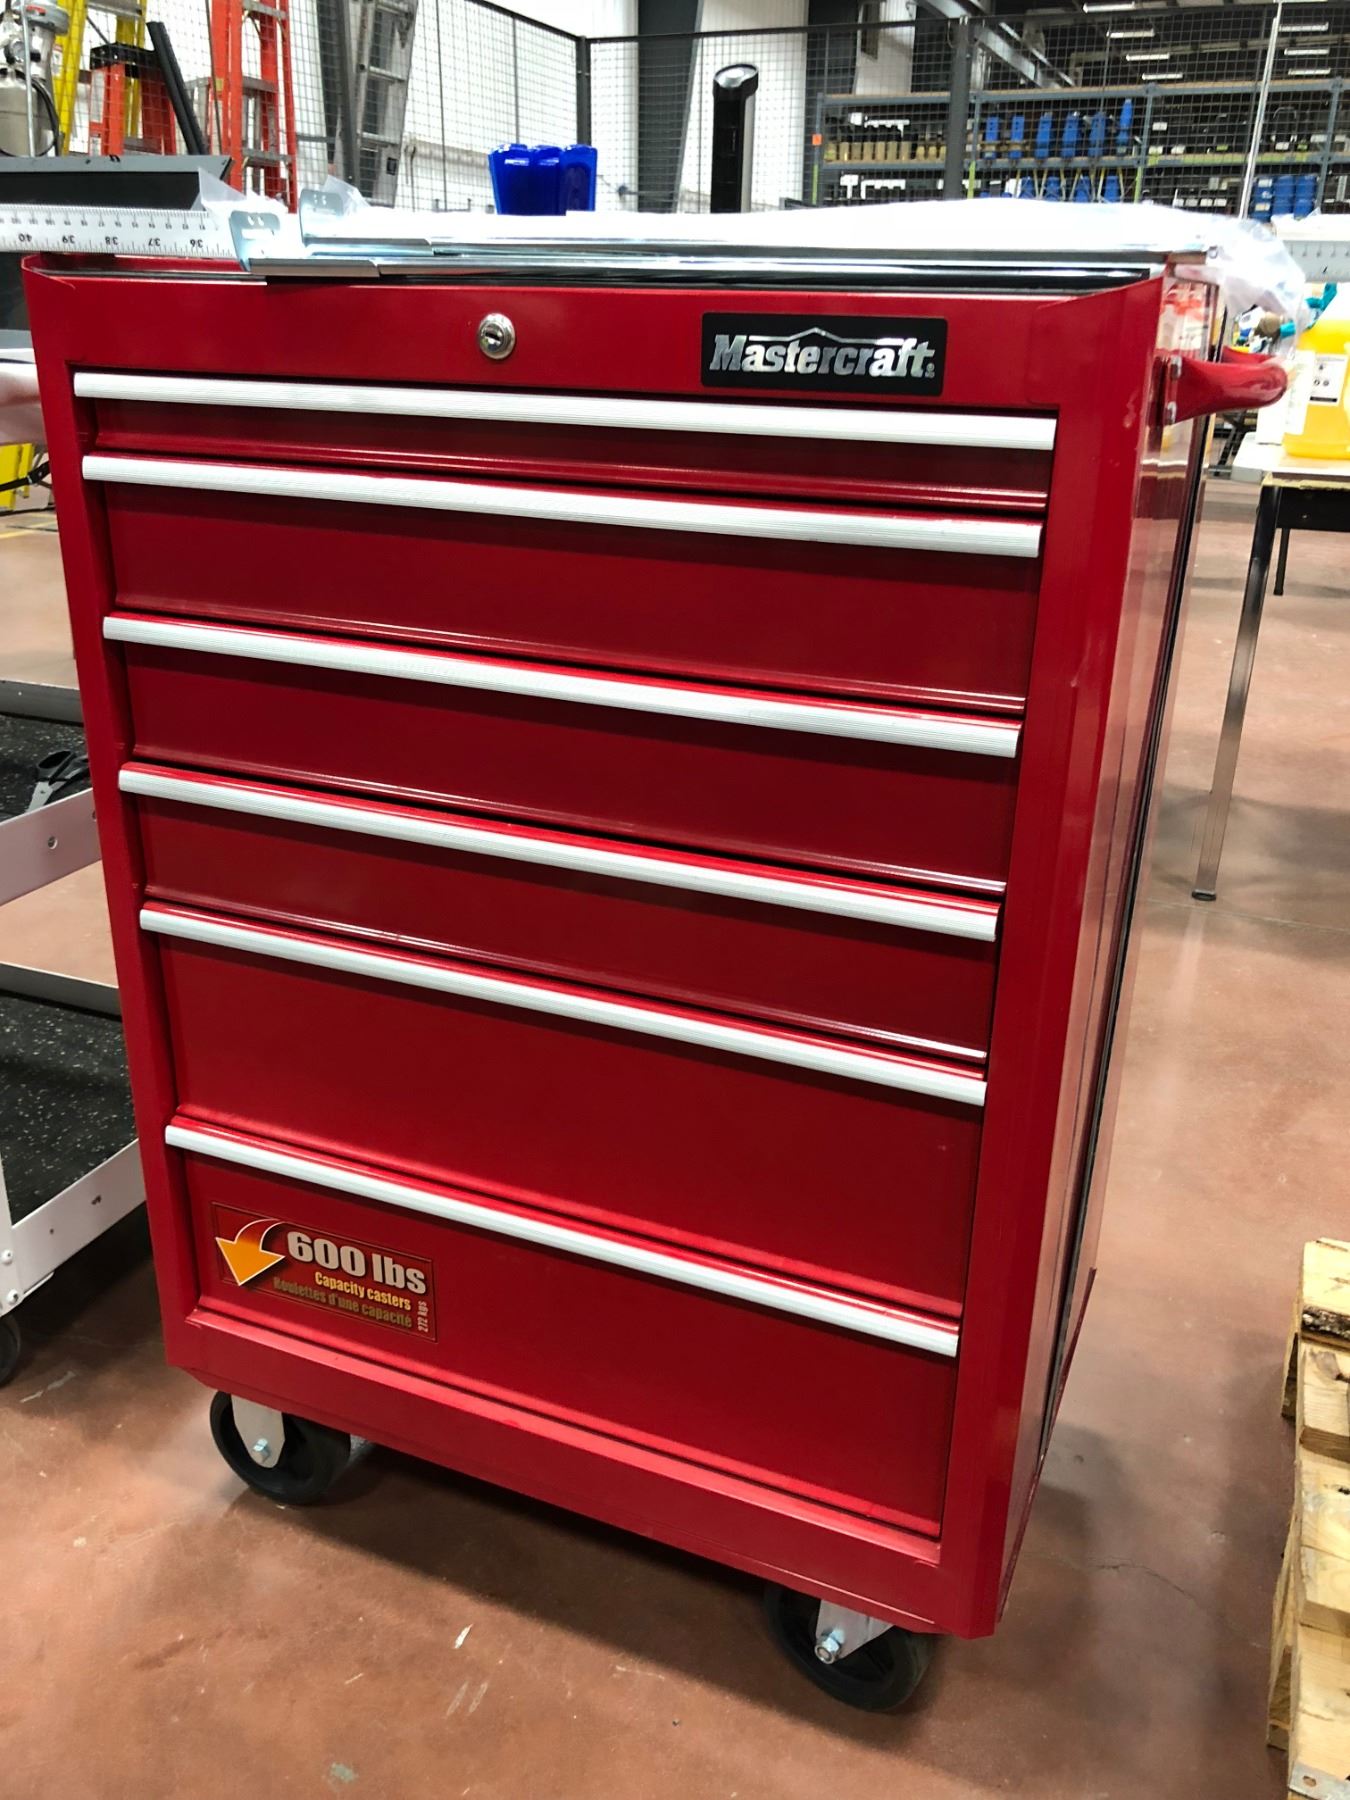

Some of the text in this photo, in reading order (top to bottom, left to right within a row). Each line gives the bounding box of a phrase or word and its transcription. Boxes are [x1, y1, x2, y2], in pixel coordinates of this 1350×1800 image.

[18, 232, 203, 248] 36 37 38 39 40
[709, 334, 935, 379] Mastercraft
[287, 1231, 427, 1294] 600 lbs
[273, 1277, 412, 1328] Roulettes d'une capacité
[315, 1271, 412, 1311] Capacity casters
